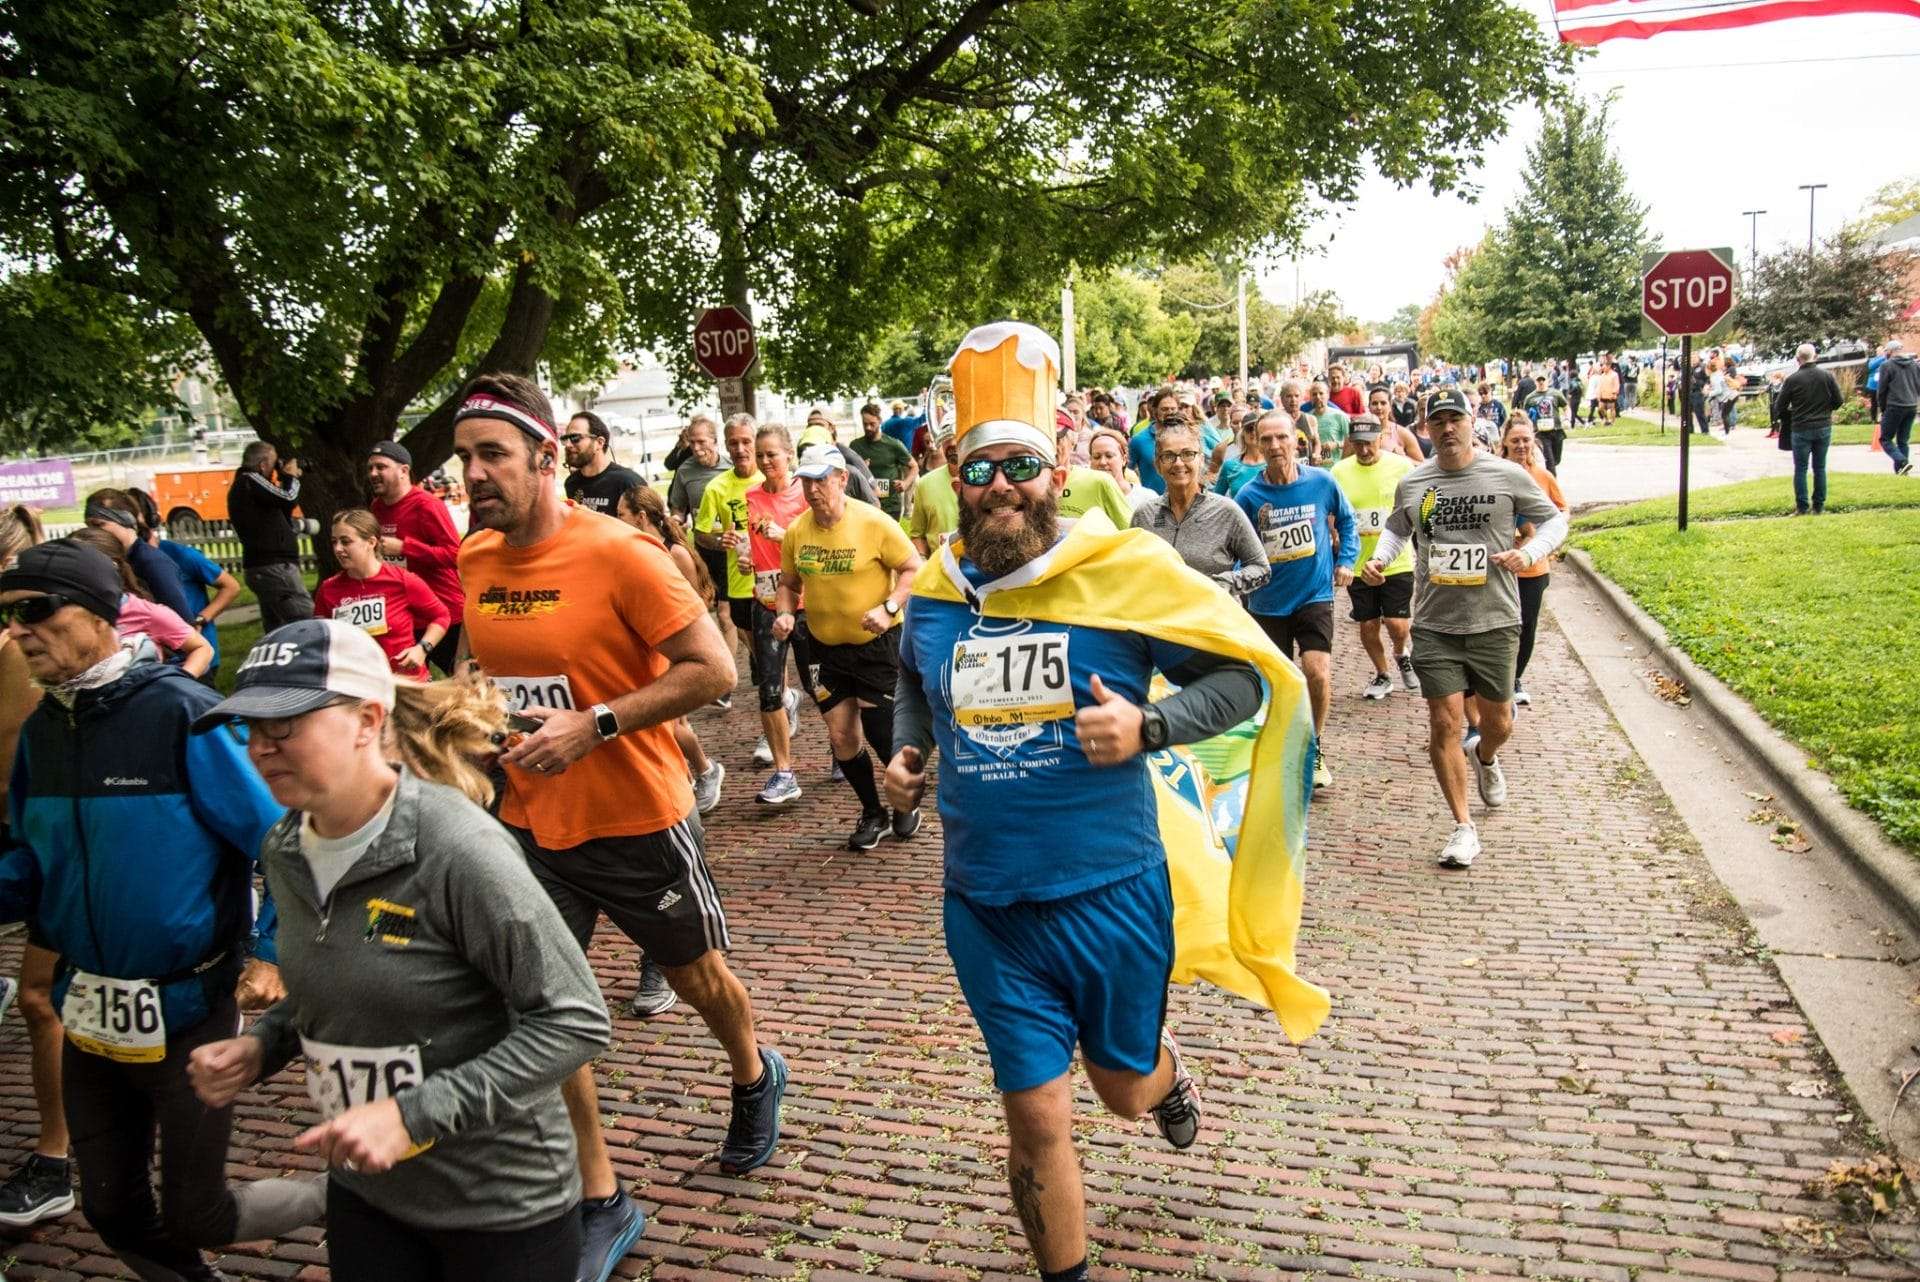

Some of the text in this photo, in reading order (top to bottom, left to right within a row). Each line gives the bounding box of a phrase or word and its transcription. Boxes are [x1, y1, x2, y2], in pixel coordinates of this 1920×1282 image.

[1648, 275, 1728, 310] STOP
[699, 328, 750, 358] STOP
[1437, 495, 1496, 507] DEKALB
[1269, 504, 1316, 518] ROTARY RUN
[1371, 511, 1379, 527] 8
[1434, 513, 1491, 526] CLASSIC
[1280, 524, 1313, 549] 200
[817, 548, 856, 562] CLASSIC
[1449, 548, 1486, 571] 212
[511, 590, 561, 603] CLASSIC
[352, 602, 383, 626] 209
[996, 642, 1065, 693] 175
[980, 762, 1017, 772] BREWING
[1019, 757, 1061, 769] COMPANY
[112, 776, 148, 786] Columbia
[95, 984, 160, 1034] 156
[329, 1058, 415, 1108] 176
